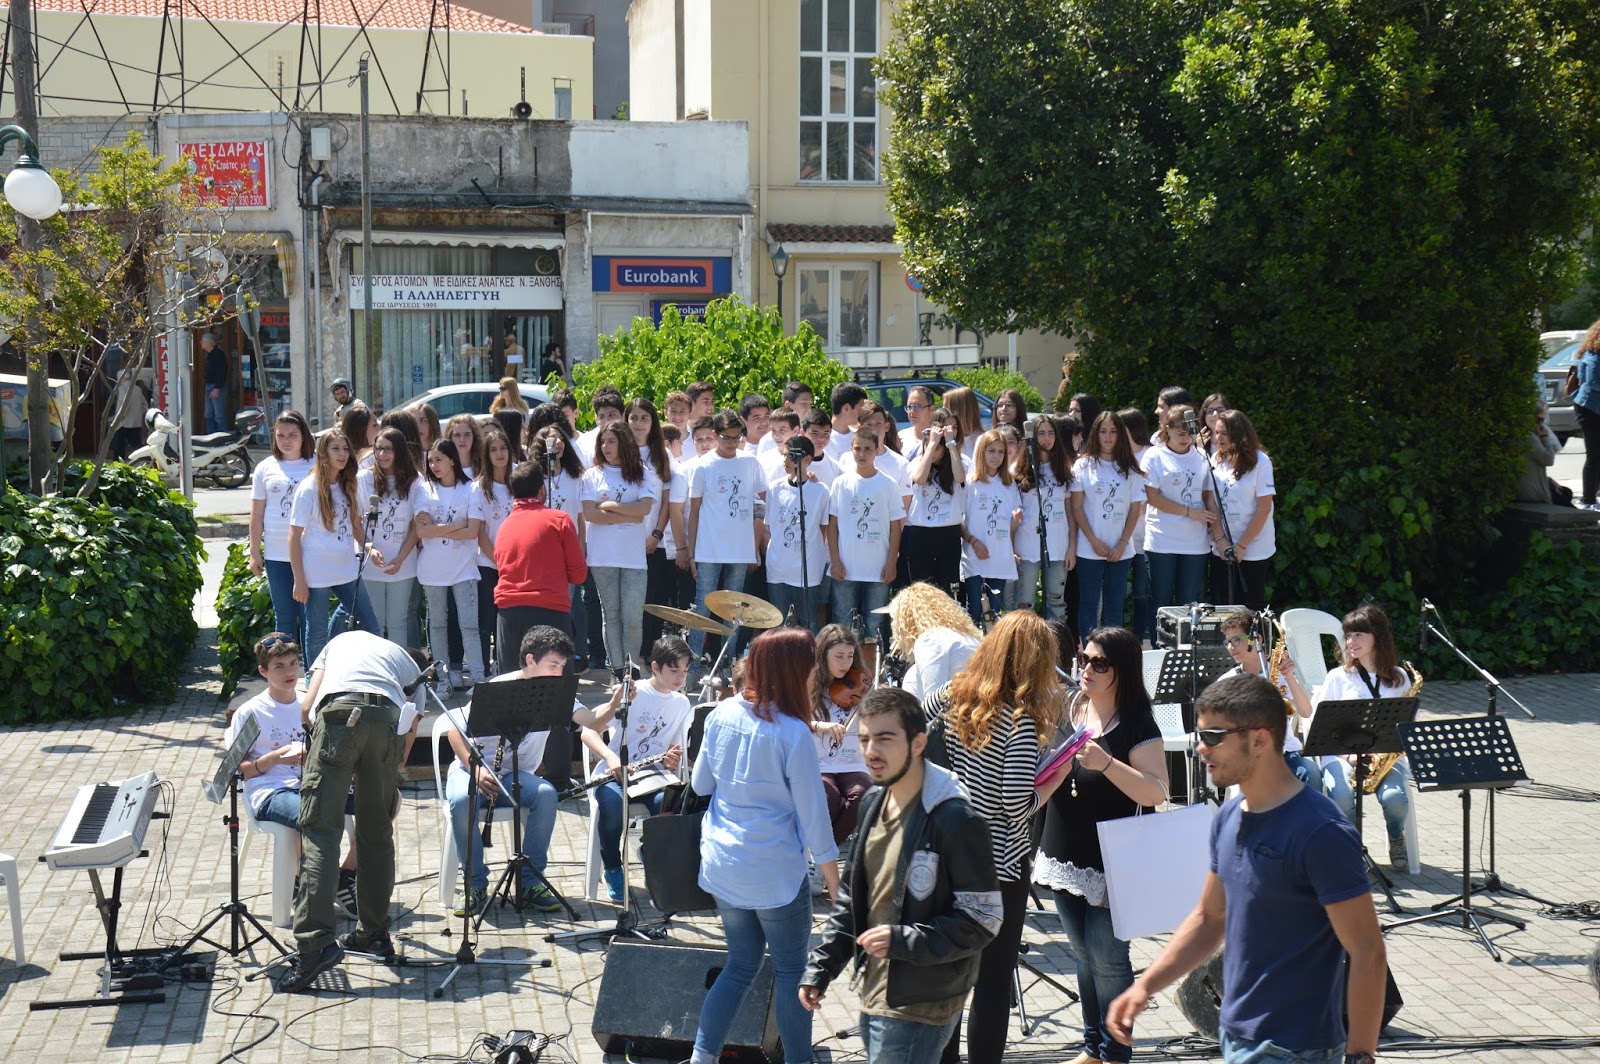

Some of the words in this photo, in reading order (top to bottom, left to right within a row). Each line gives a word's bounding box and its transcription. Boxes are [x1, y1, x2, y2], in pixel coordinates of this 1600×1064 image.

[180, 142, 264, 158] ΚΛΕΙΔΑΡΑΣ
[351, 276, 392, 287] ΣΥΟΓΟΣ
[394, 276, 427, 287] ΑΤΟΜΩΝ
[433, 276, 445, 287] ΜΕ
[447, 277, 477, 288] ΕΙΔΙΚΕΣ
[479, 276, 514, 288] ΑΝΑΓΚΕΣ
[529, 276, 561, 288] ΞΑΝΘΗΣ
[624, 269, 698, 284] Eurobank
[393, 290, 403, 300] Η
[407, 290, 500, 301] ΑΛΛΗΛΕΓΓΥΗ
[677, 305, 707, 315] roban
